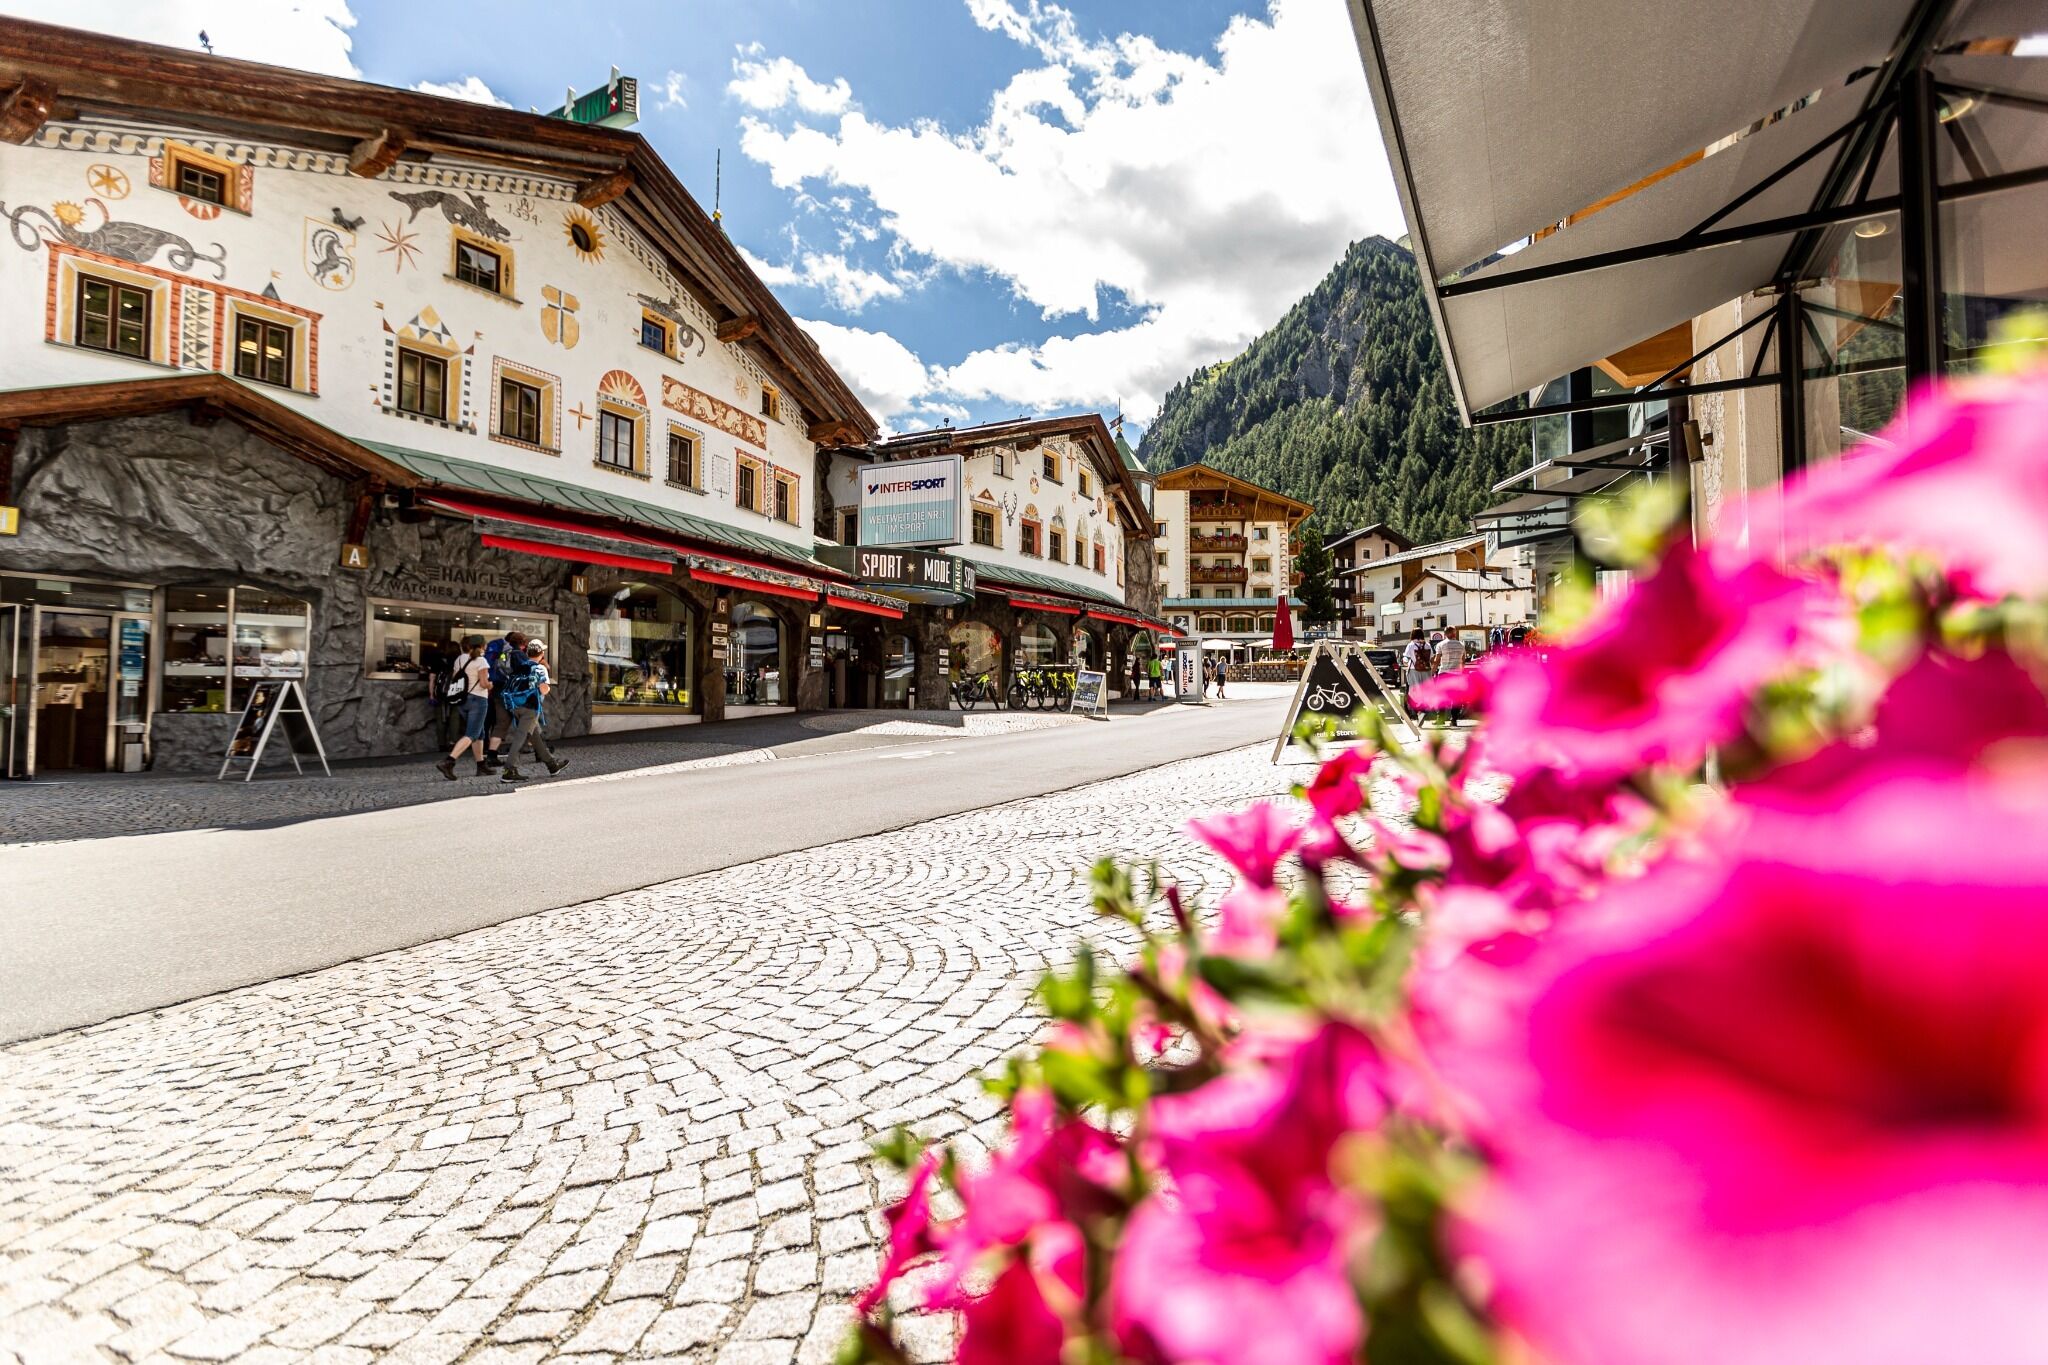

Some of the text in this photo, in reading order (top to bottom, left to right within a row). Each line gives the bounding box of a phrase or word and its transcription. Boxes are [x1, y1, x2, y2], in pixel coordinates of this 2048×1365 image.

[624, 79, 636, 113] HANGL
[880, 477, 946, 494] INTERSPORT
[868, 512, 911, 525] WELTWEIT
[913, 511, 925, 521] DIE
[887, 522, 926, 534] IM SPORT
[348, 547, 361, 566] A
[441, 566, 501, 588] HANGL
[862, 553, 951, 584] SPORT MODE
[389, 580, 541, 606] WATCHES & JEWELLERY
[576, 577, 584, 593] N
[719, 600, 726, 612] G
